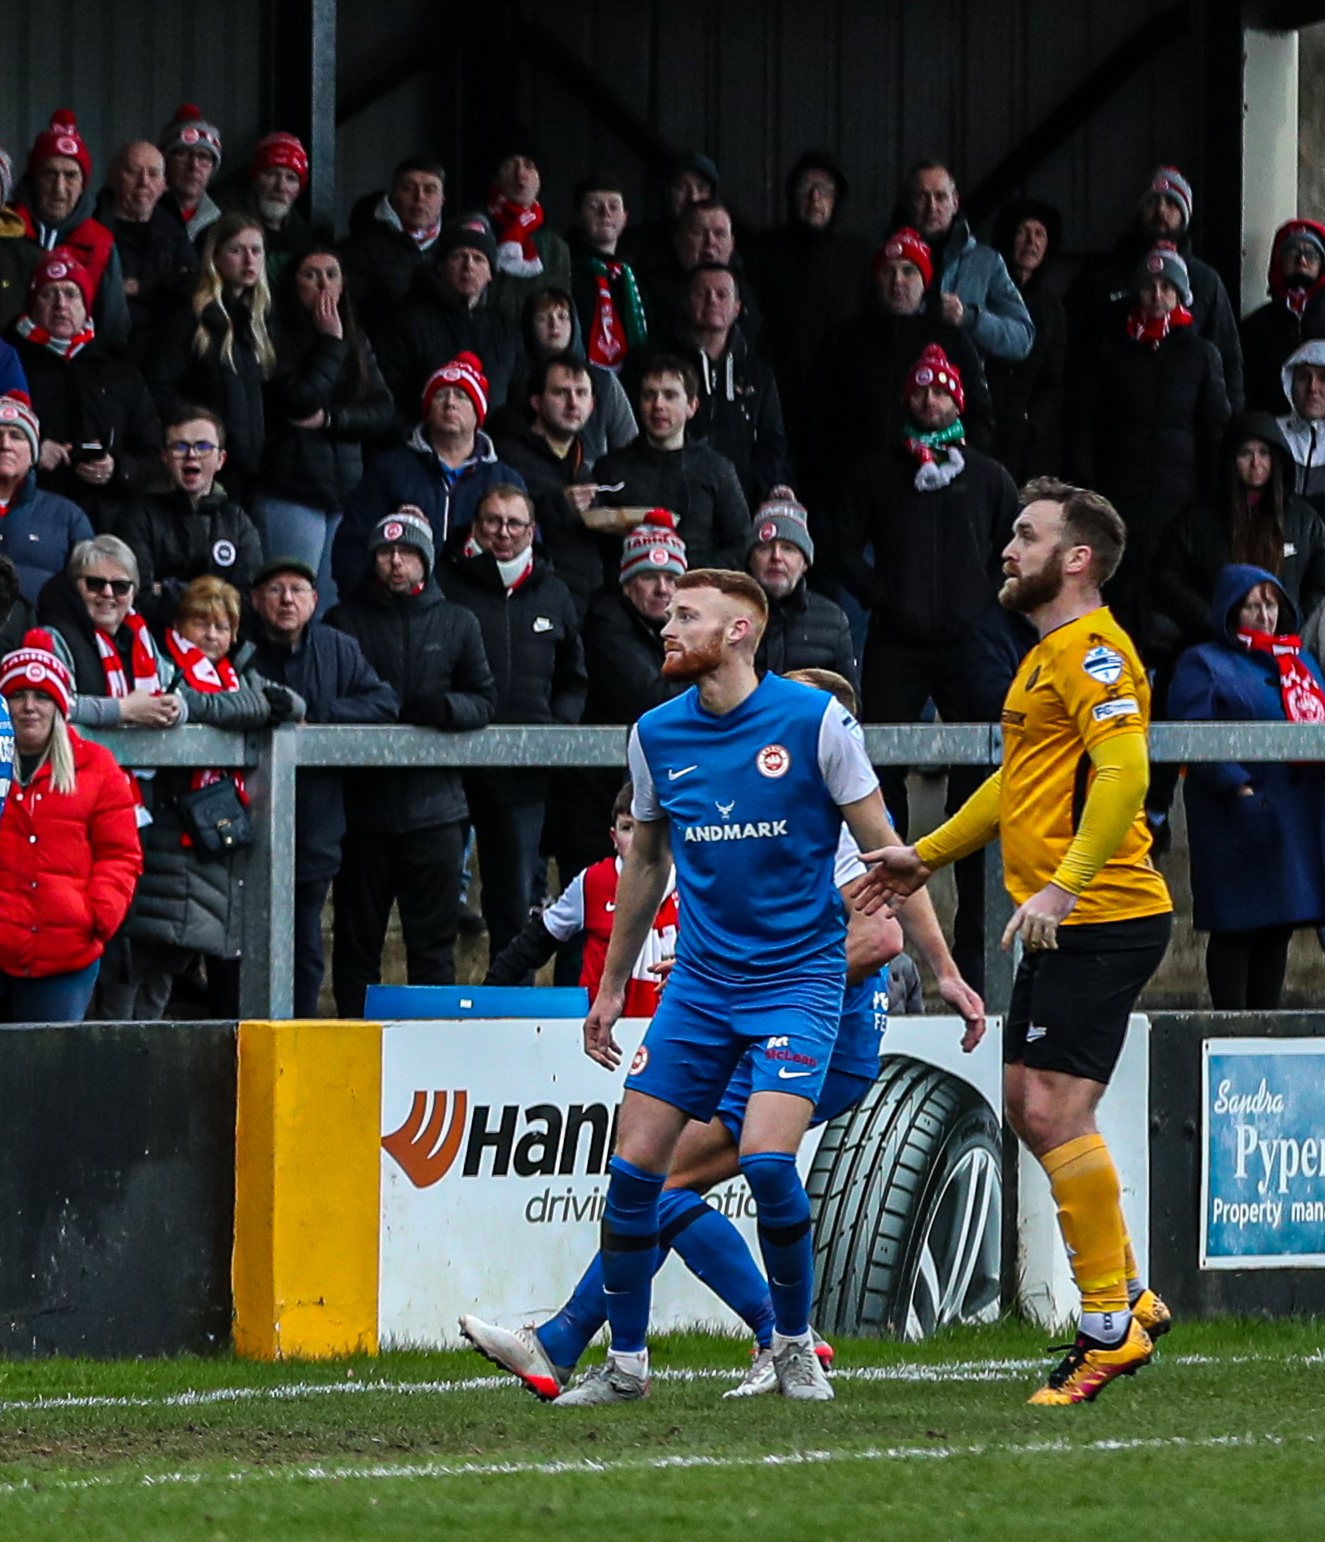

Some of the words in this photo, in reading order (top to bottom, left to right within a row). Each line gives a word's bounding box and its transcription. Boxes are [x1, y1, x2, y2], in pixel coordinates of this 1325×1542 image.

[684, 819, 788, 842] ANDMARK
[1213, 1077, 1285, 1115] Sandra
[1212, 1197, 1282, 1231] Property
